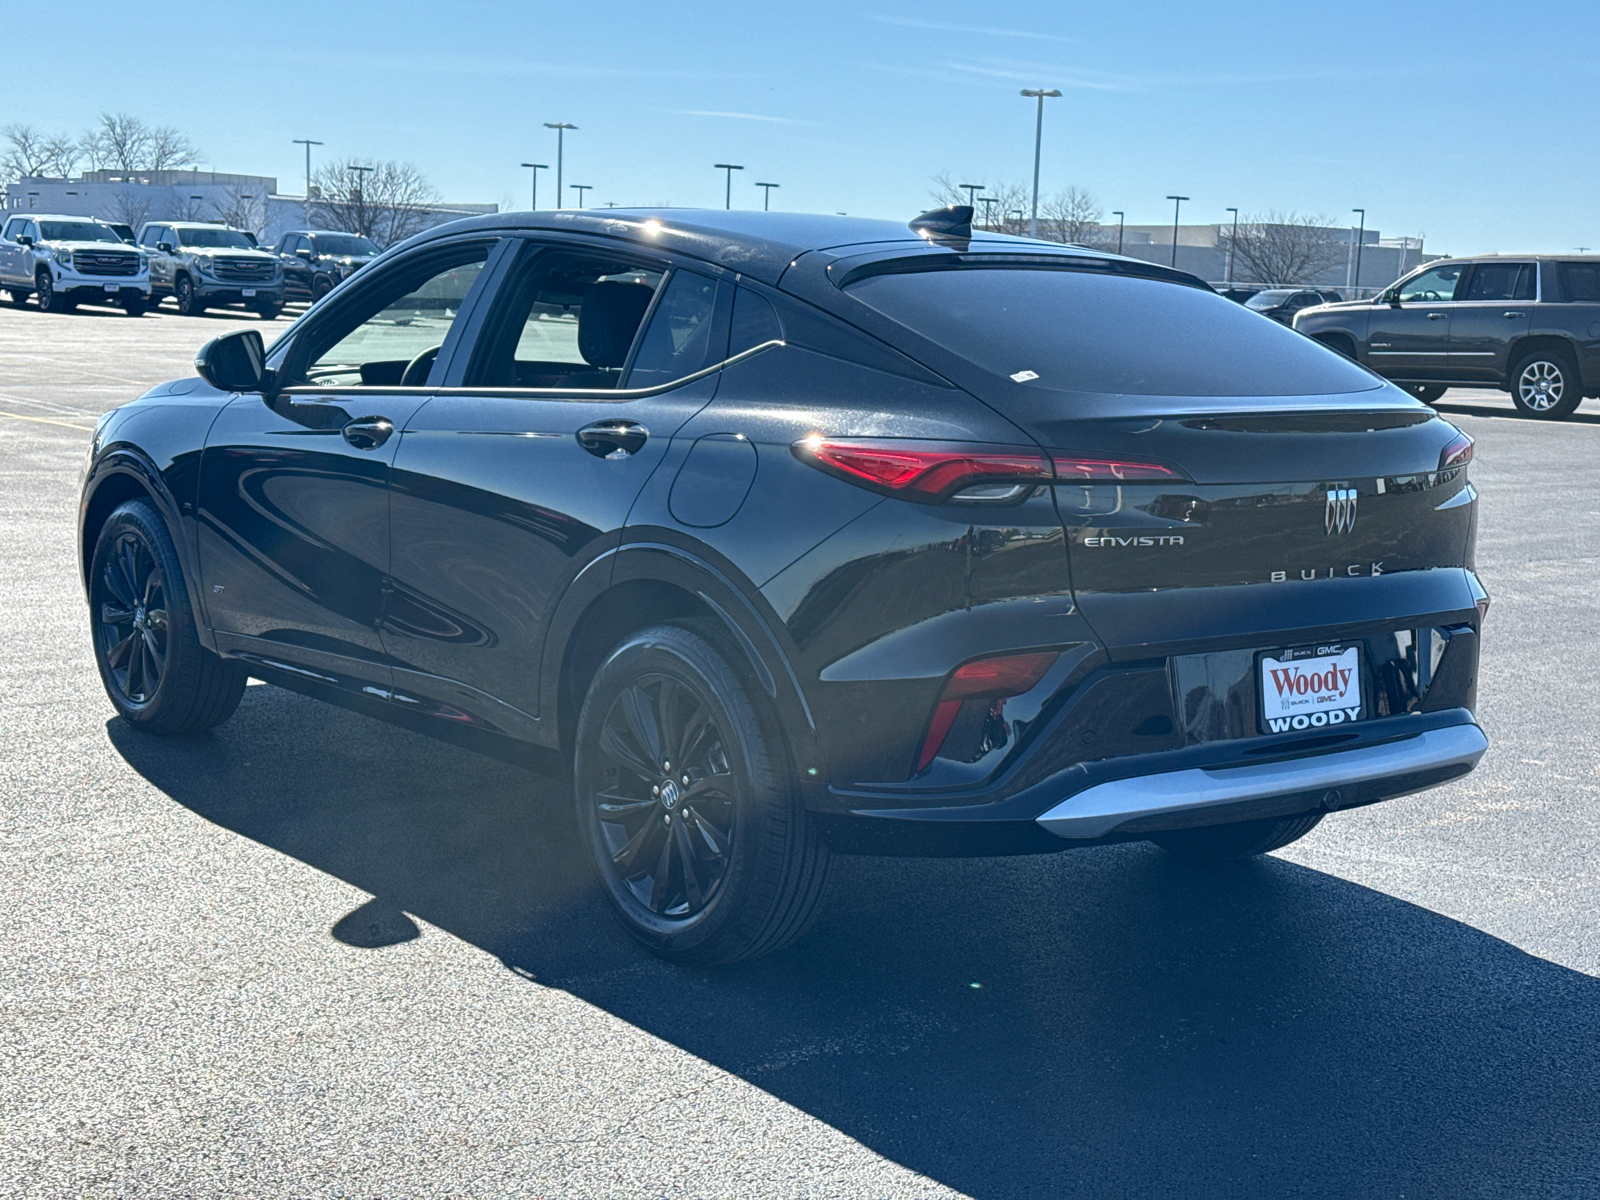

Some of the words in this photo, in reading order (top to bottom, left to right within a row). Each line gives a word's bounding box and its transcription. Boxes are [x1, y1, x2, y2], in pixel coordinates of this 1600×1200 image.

[1084, 535, 1185, 548] ENVISTA
[1270, 561, 1385, 583] BUICK
[1317, 645, 1341, 655] GMC
[1269, 662, 1353, 698] Woody
[1291, 698, 1310, 706] BUICK
[1316, 694, 1337, 704] GMC
[1268, 706, 1362, 734] WOODY
